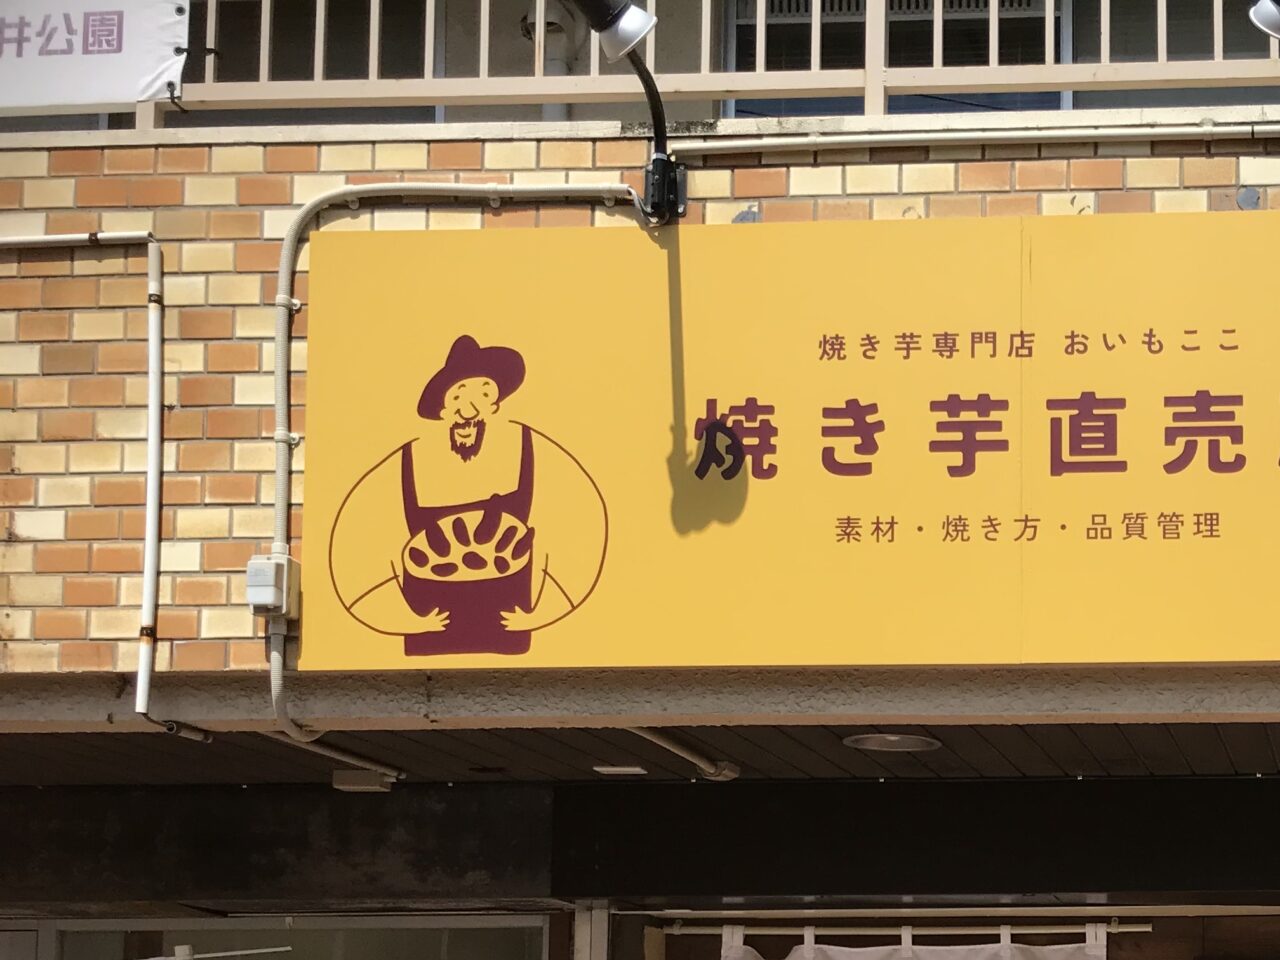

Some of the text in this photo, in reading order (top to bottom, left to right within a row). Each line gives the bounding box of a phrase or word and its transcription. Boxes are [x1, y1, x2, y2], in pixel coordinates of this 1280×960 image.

[818, 328, 1241, 361] 焼き芋専門店 おいもここ
[834, 512, 1223, 544] 素材・焼き方・品質管理
